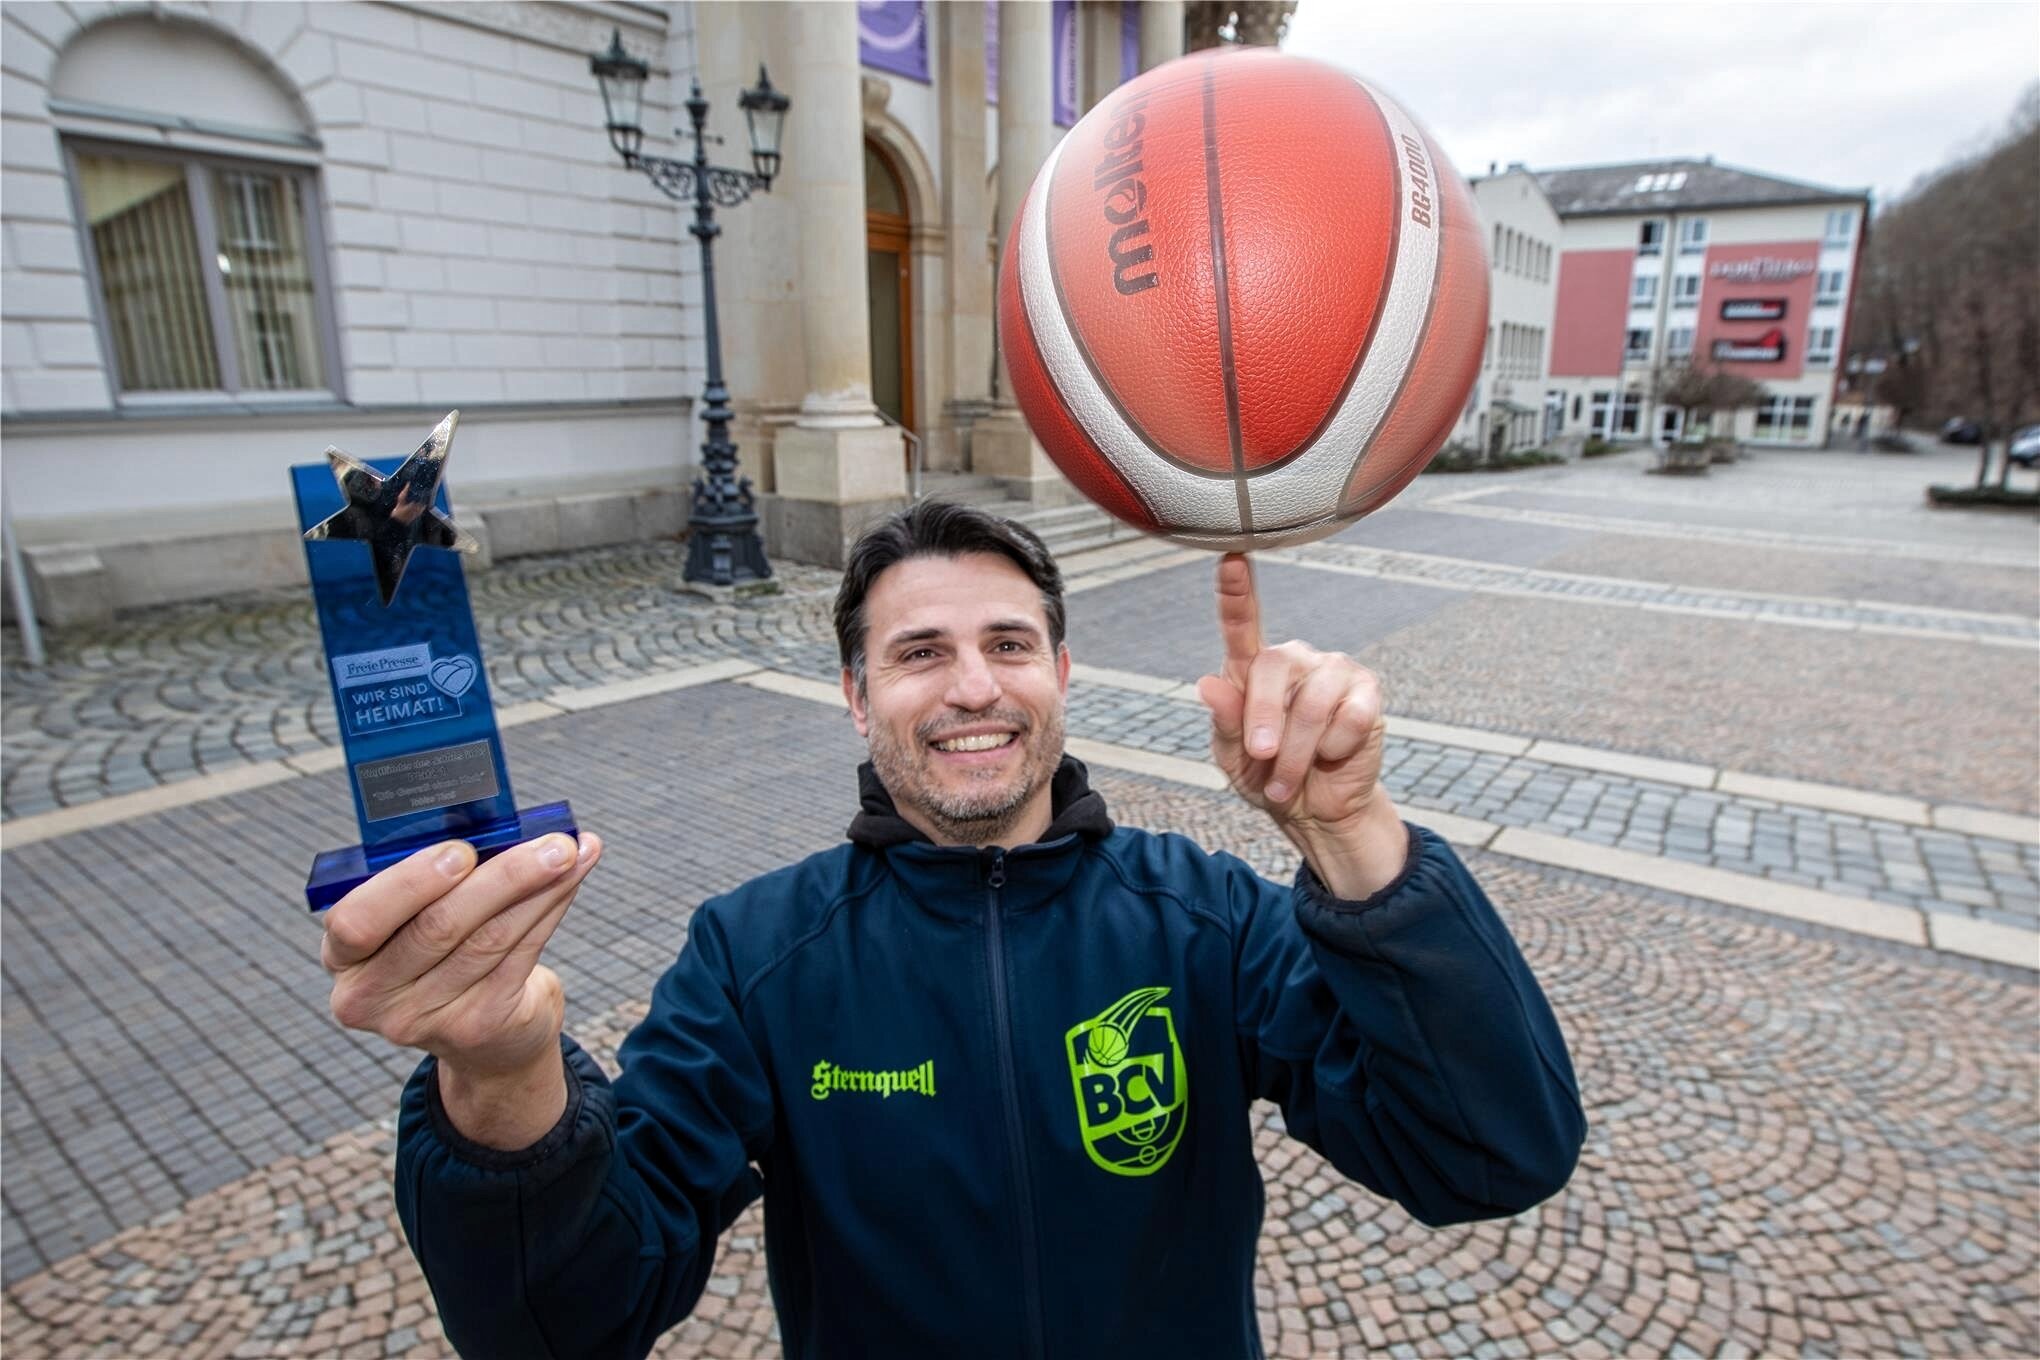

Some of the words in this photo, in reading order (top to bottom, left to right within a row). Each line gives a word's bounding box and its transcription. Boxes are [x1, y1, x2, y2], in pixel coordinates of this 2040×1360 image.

[1094, 95, 1159, 296] molten
[1401, 133, 1432, 229] BG4000
[352, 690, 384, 705] WIR
[390, 683, 428, 699] SIND
[356, 697, 445, 725] HEIMAT!
[811, 1059, 936, 1100] Sternquell
[1080, 1050, 1176, 1128] BCV
